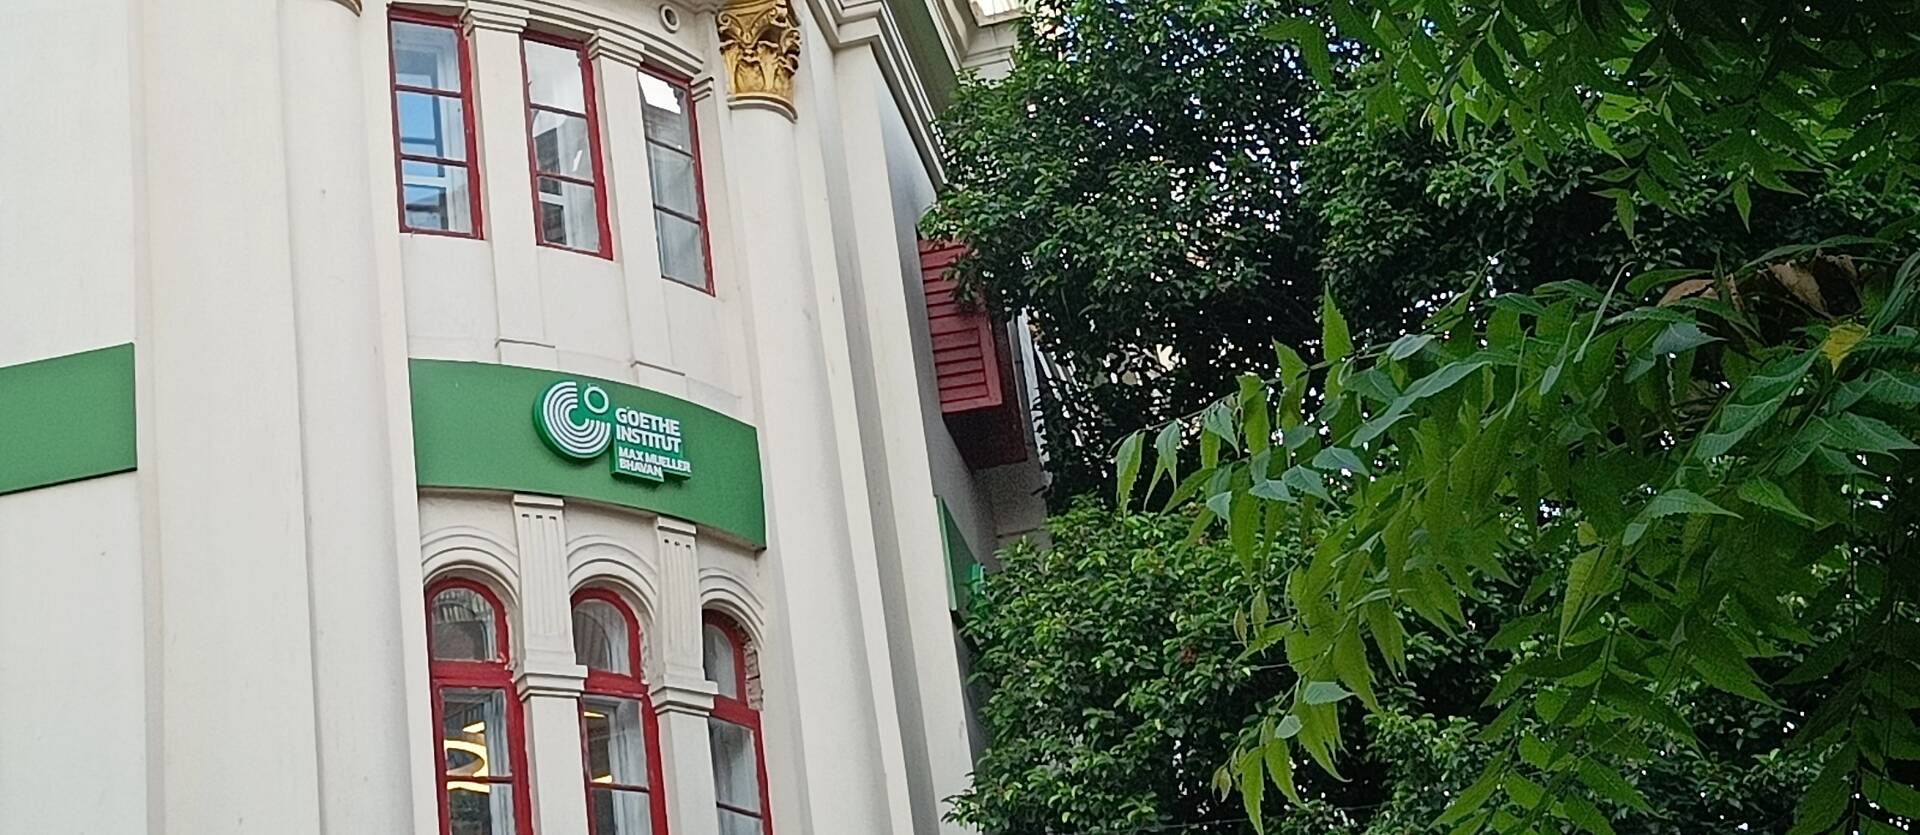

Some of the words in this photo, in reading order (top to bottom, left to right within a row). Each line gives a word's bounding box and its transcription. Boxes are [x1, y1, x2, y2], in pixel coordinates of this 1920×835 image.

[615, 408, 681, 436] GOETHE
[616, 424, 681, 453] INSTITUT
[619, 447, 644, 462] MAX
[644, 452, 691, 472] MUELLER
[619, 458, 663, 477] BHAVAN
